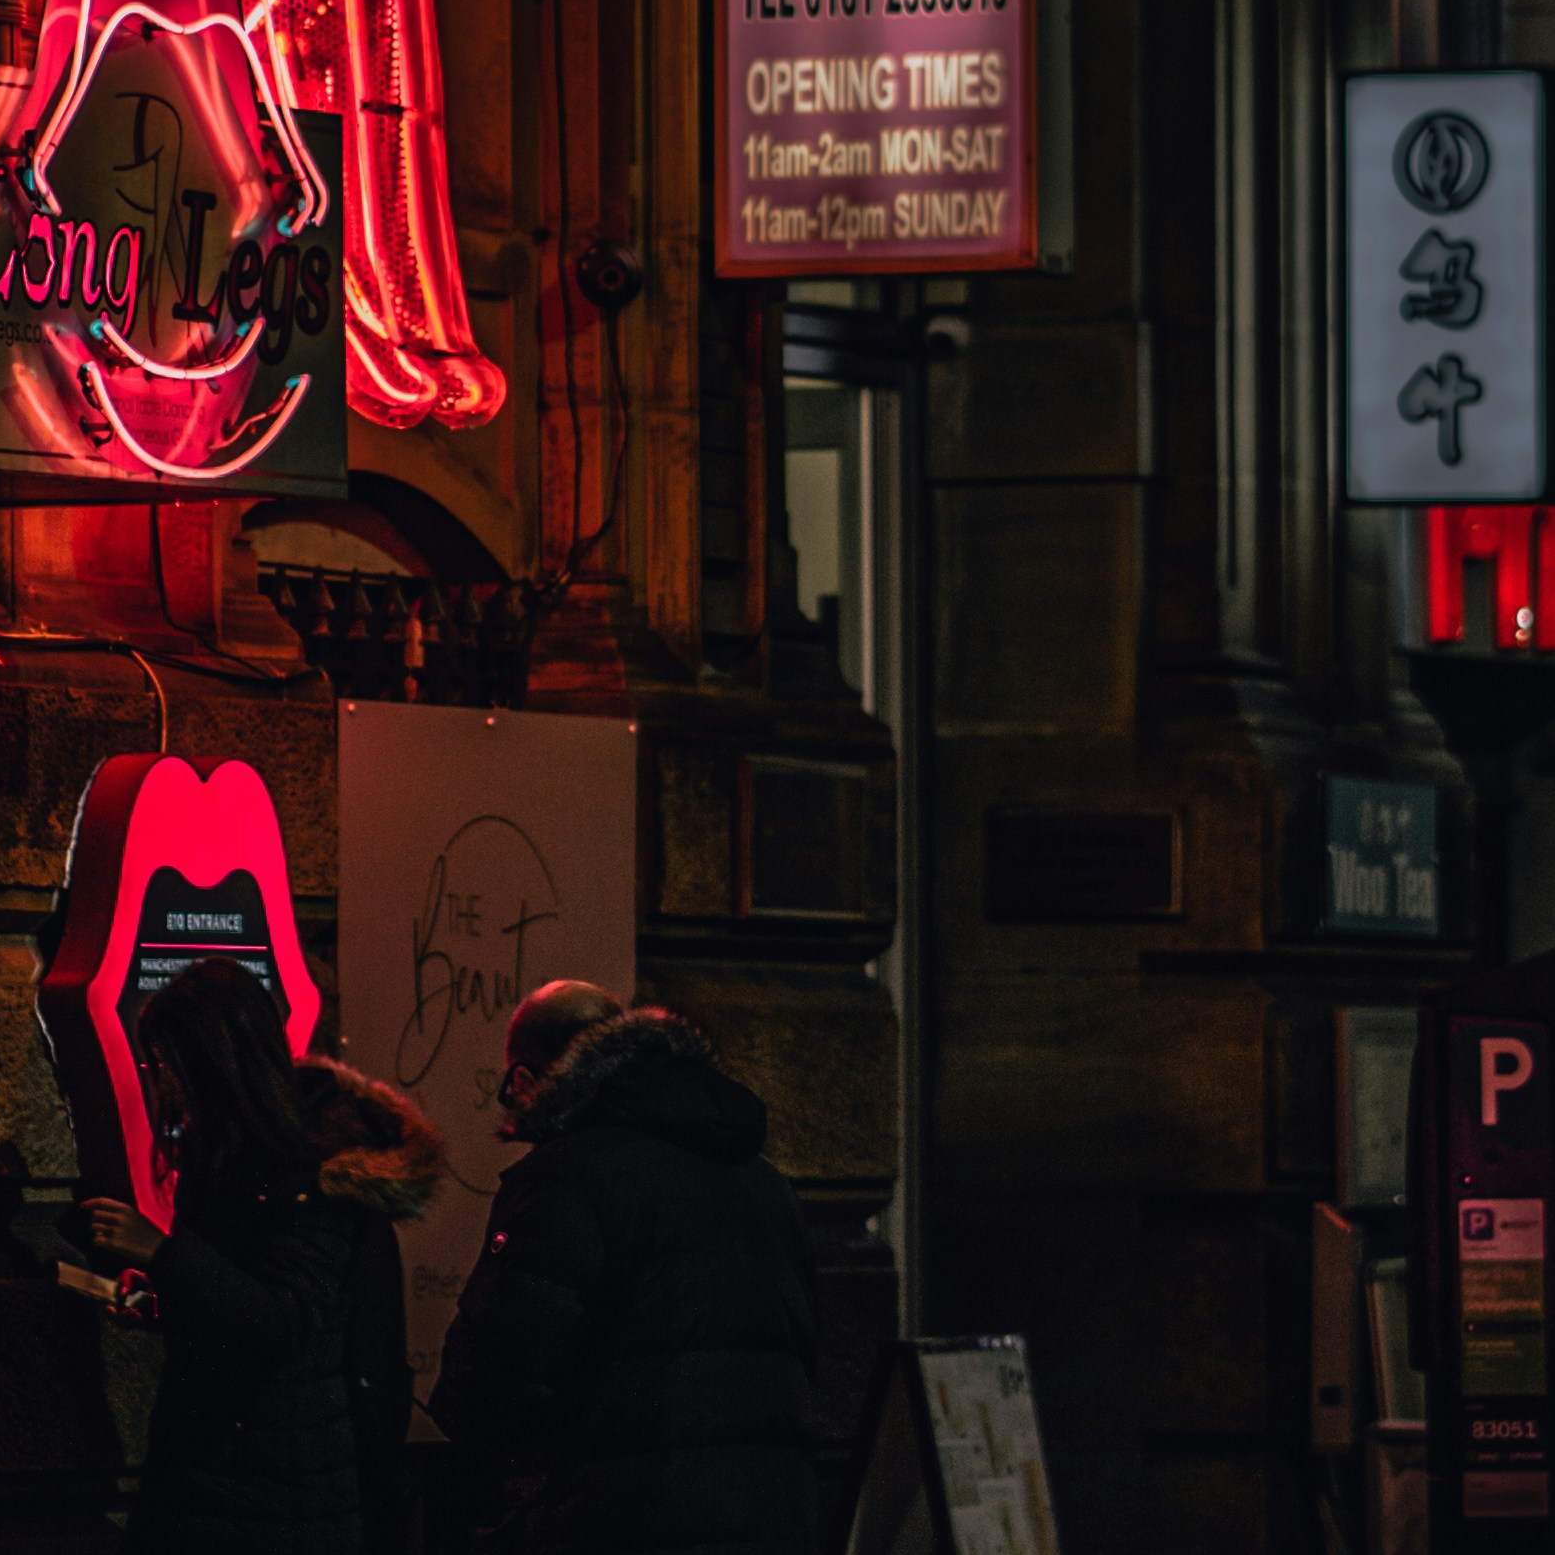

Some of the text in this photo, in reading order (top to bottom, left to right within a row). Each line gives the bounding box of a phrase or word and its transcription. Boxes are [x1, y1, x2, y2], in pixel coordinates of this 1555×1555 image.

[746, 50, 1004, 116] OPENING TIMES
[743, 125, 1006, 180] 11am-2am MON-SAT
[741, 189, 1006, 251] 11am-12pm SUNDAY
[172, 189, 332, 366] Legs
[186, 912, 244, 934] ENTRANCE
[445, 892, 481, 938] THE
[395, 853, 559, 1089] Beaut
[1480, 1035, 1534, 1126] P
